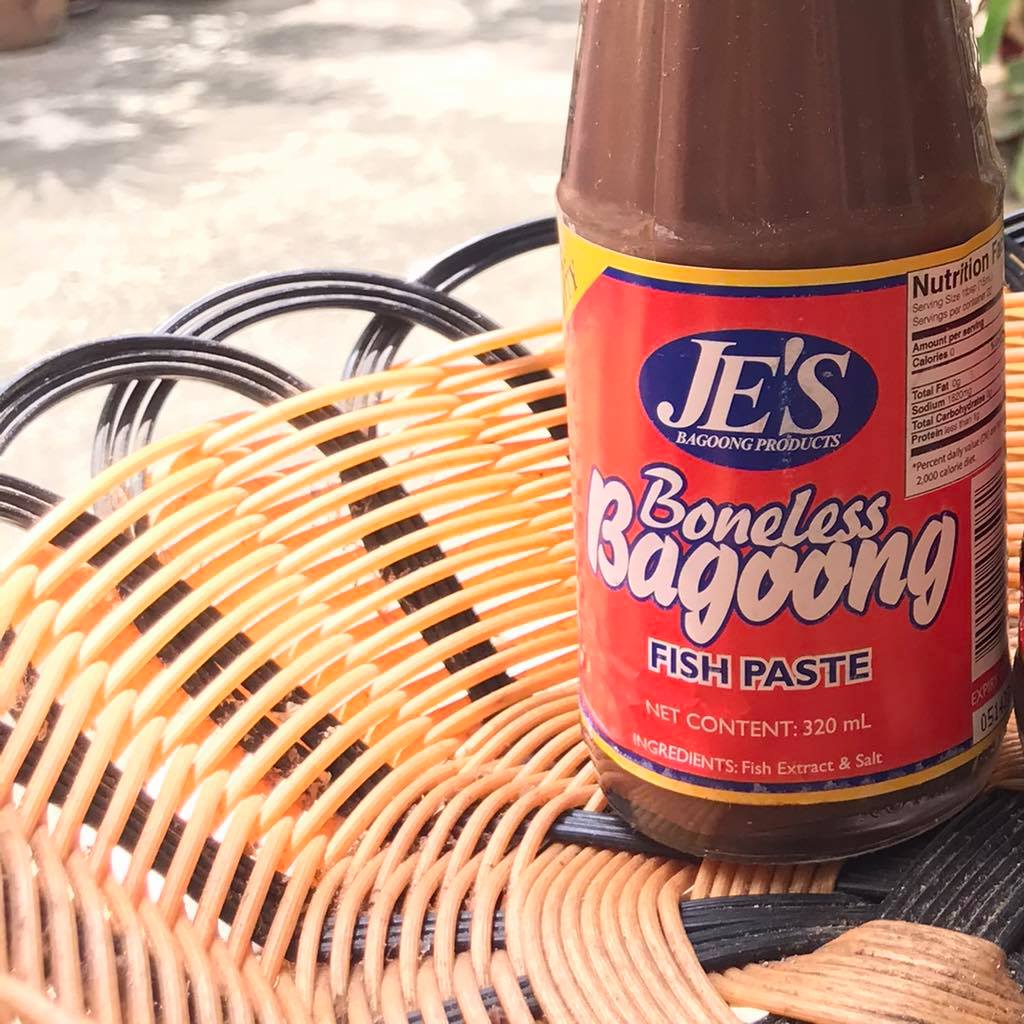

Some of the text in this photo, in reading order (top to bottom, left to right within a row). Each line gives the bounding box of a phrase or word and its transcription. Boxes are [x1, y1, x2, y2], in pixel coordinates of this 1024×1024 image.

[912, 252, 989, 299] Nutrition
[912, 298, 944, 314] Serving
[912, 311, 948, 327] Servings
[949, 306, 961, 319] per
[912, 319, 985, 353] Amount per serving
[912, 352, 949, 368] Calories
[656, 336, 852, 435] JE'S
[912, 386, 934, 400] Total
[936, 381, 950, 394] Fat
[912, 398, 946, 416] Sodium
[911, 428, 944, 444] Protein
[912, 416, 934, 431] Total
[675, 431, 842, 452] BAGOONG PRODUCTS
[639, 463, 889, 546] Boneless
[584, 465, 959, 647] Bagoong
[648, 638, 873, 691] FISH PASTE
[645, 699, 872, 737] NET CONTENT: 320 mL
[632, 732, 883, 776] INGREDIENTS: Fish Extract & Salt
